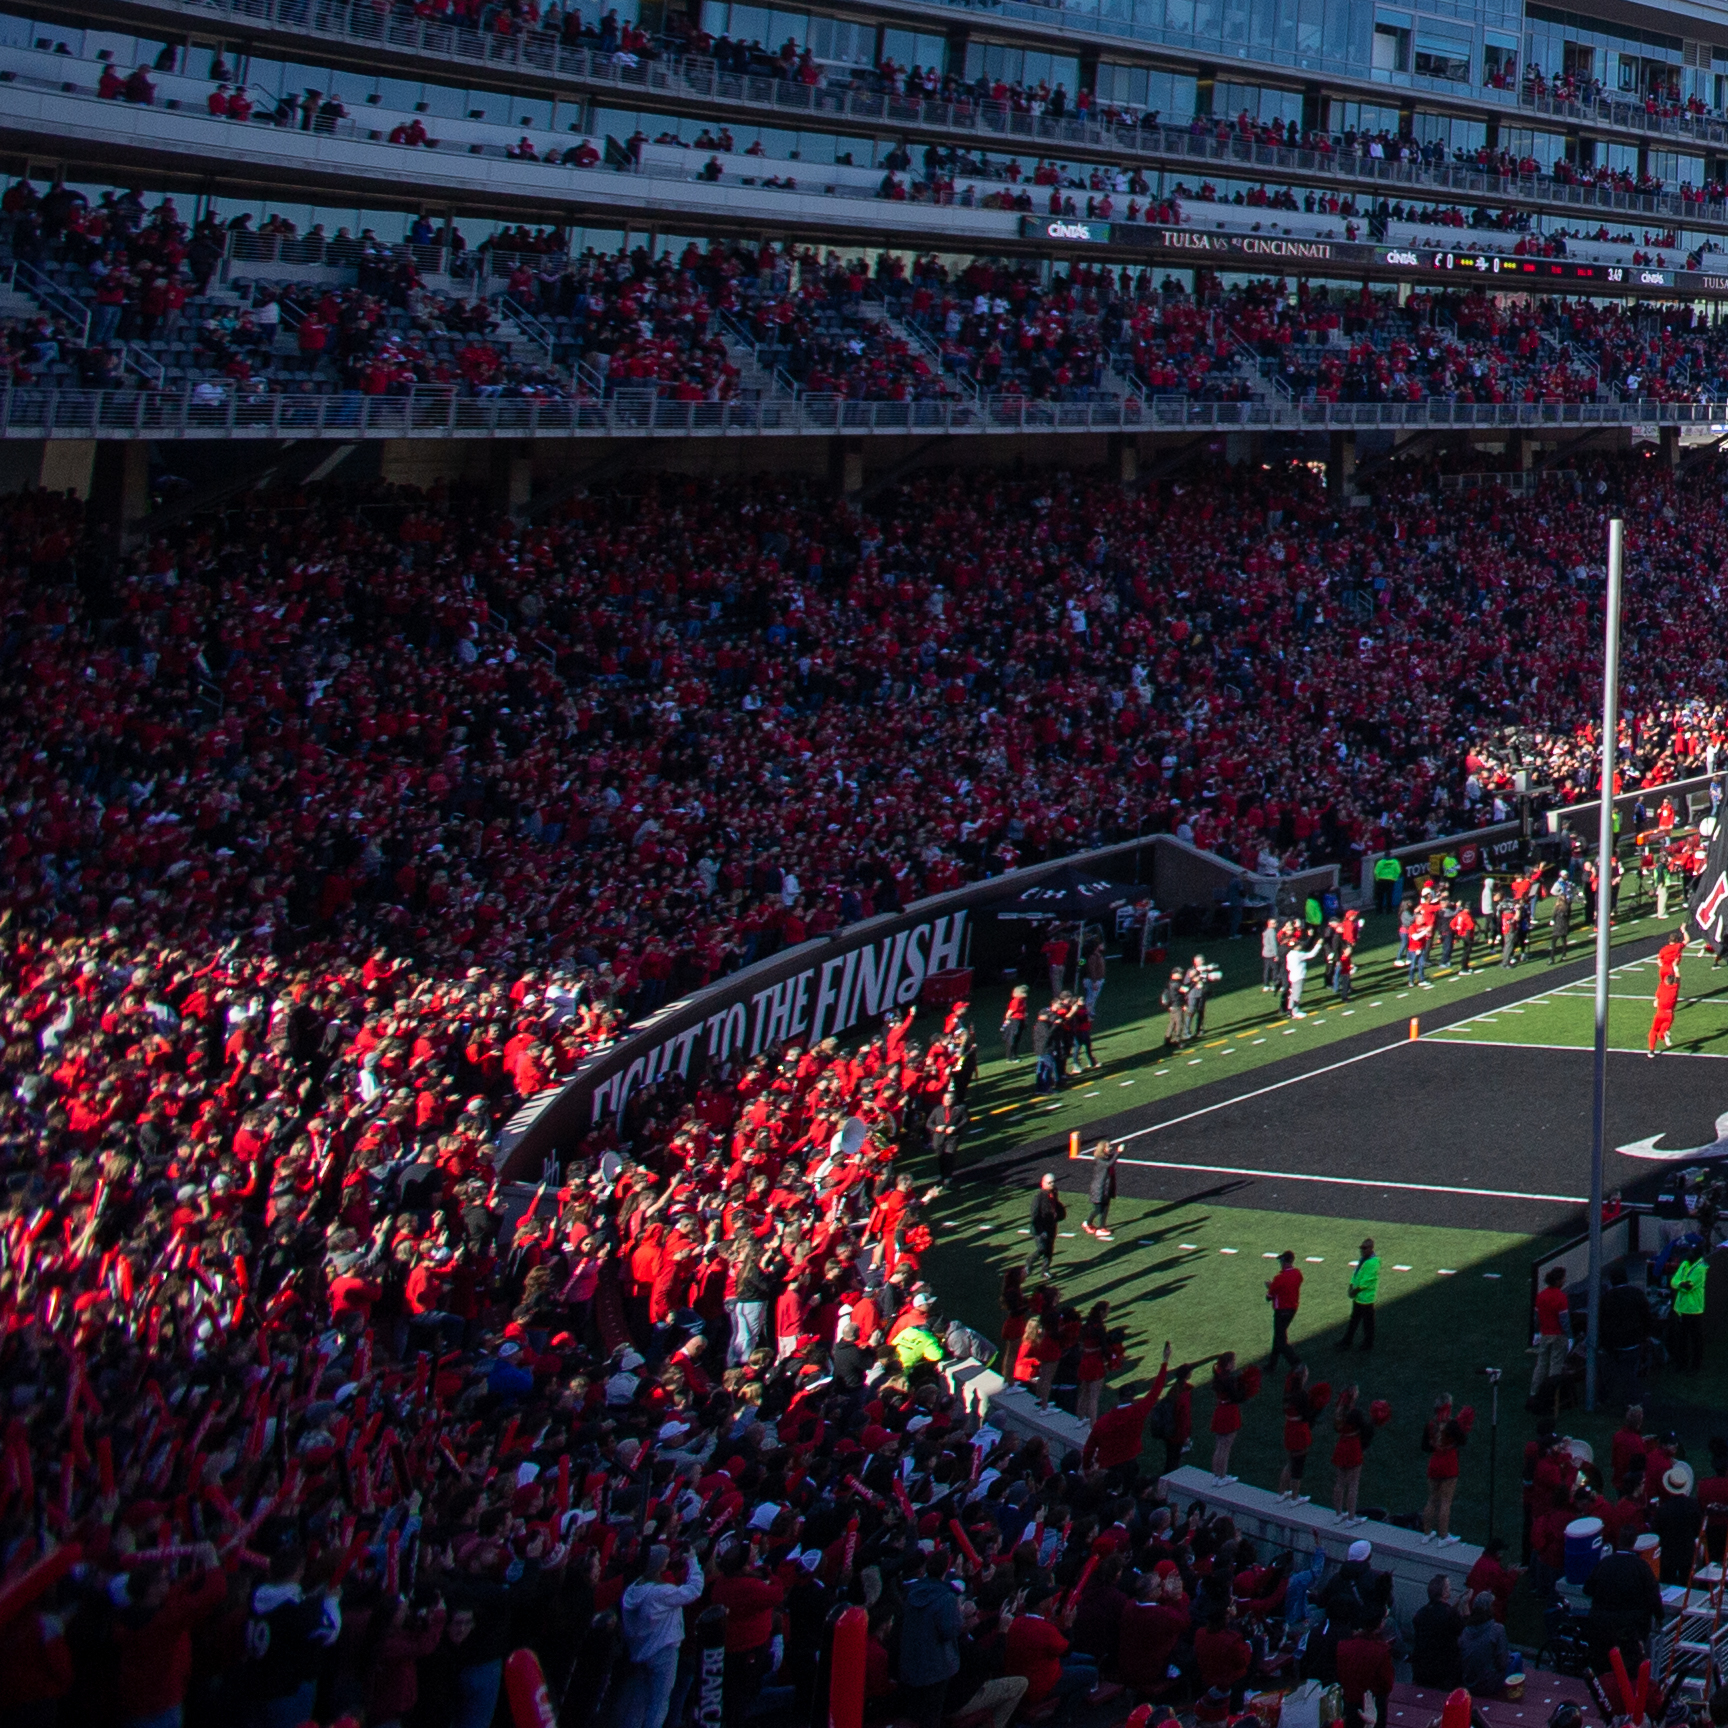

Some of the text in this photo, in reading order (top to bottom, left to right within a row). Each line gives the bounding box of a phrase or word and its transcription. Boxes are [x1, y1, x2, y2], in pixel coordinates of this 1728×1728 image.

[1162, 230, 1210, 249] TULSA
[1243, 238, 1331, 259] CINCINNATI
[707, 1002, 747, 1067] TO
[749, 968, 816, 1059] THE
[808, 909, 969, 1050] FINISH
